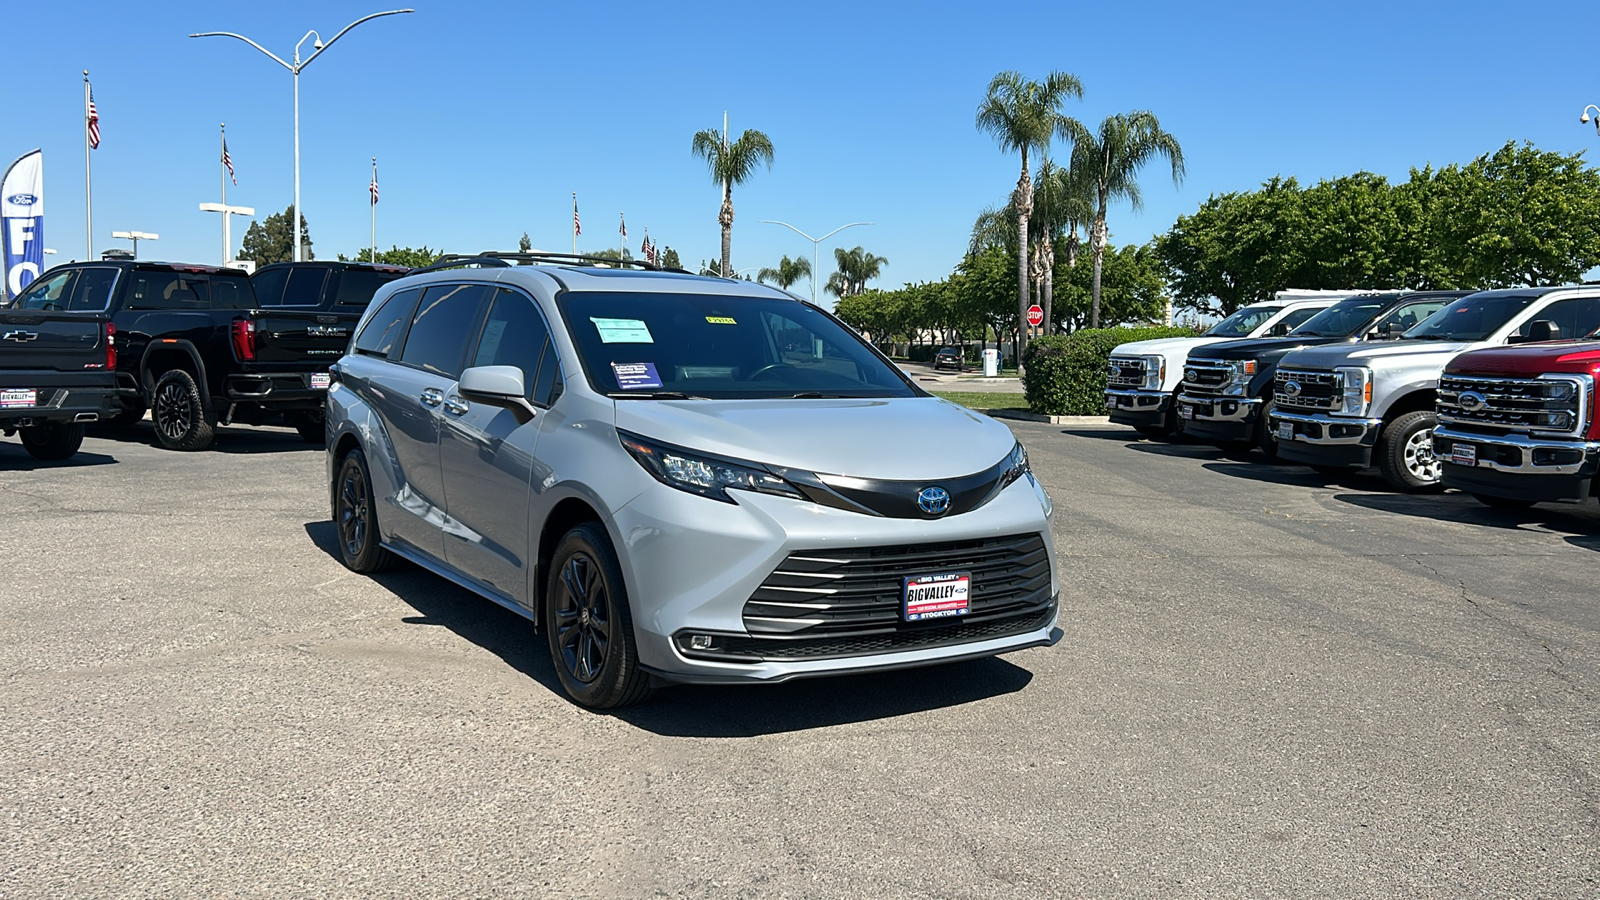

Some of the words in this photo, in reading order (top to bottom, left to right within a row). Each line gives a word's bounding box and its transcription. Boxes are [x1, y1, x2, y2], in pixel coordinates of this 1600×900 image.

[1028, 311, 1043, 320] STOP
[908, 585, 955, 602] BIGVALLEY
[920, 609, 957, 619] STOCKTON
